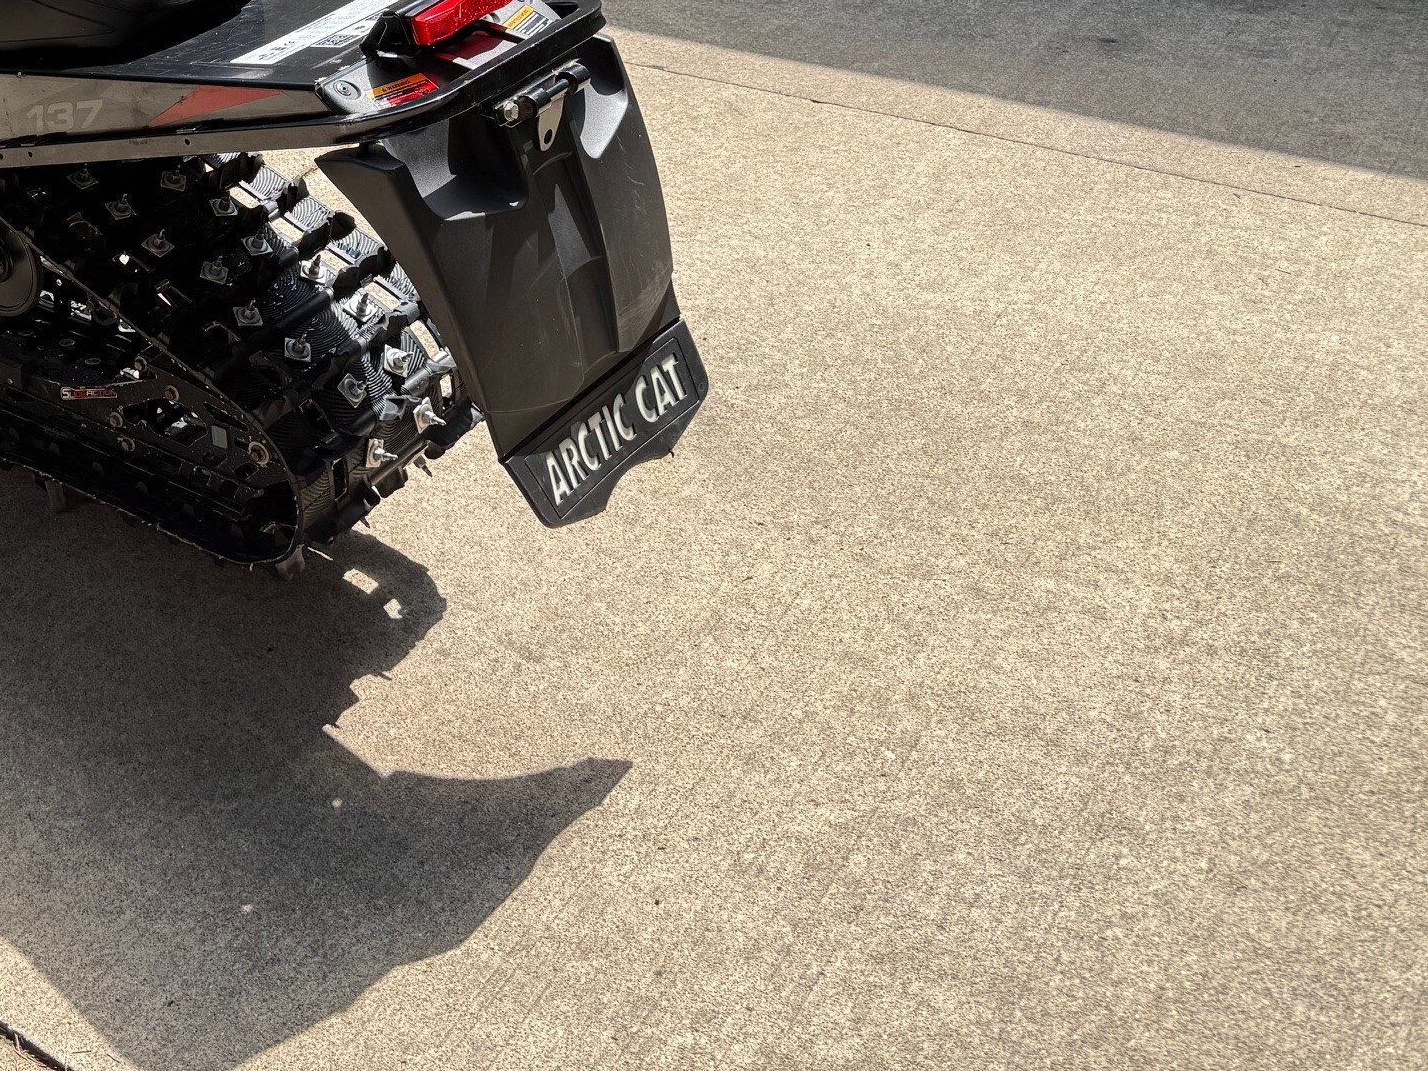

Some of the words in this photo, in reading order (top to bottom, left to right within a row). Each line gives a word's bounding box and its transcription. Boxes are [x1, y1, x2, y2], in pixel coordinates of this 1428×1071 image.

[26, 99, 103, 133] 137
[545, 393, 637, 506] ARCTIC
[635, 352, 687, 423] CAT
